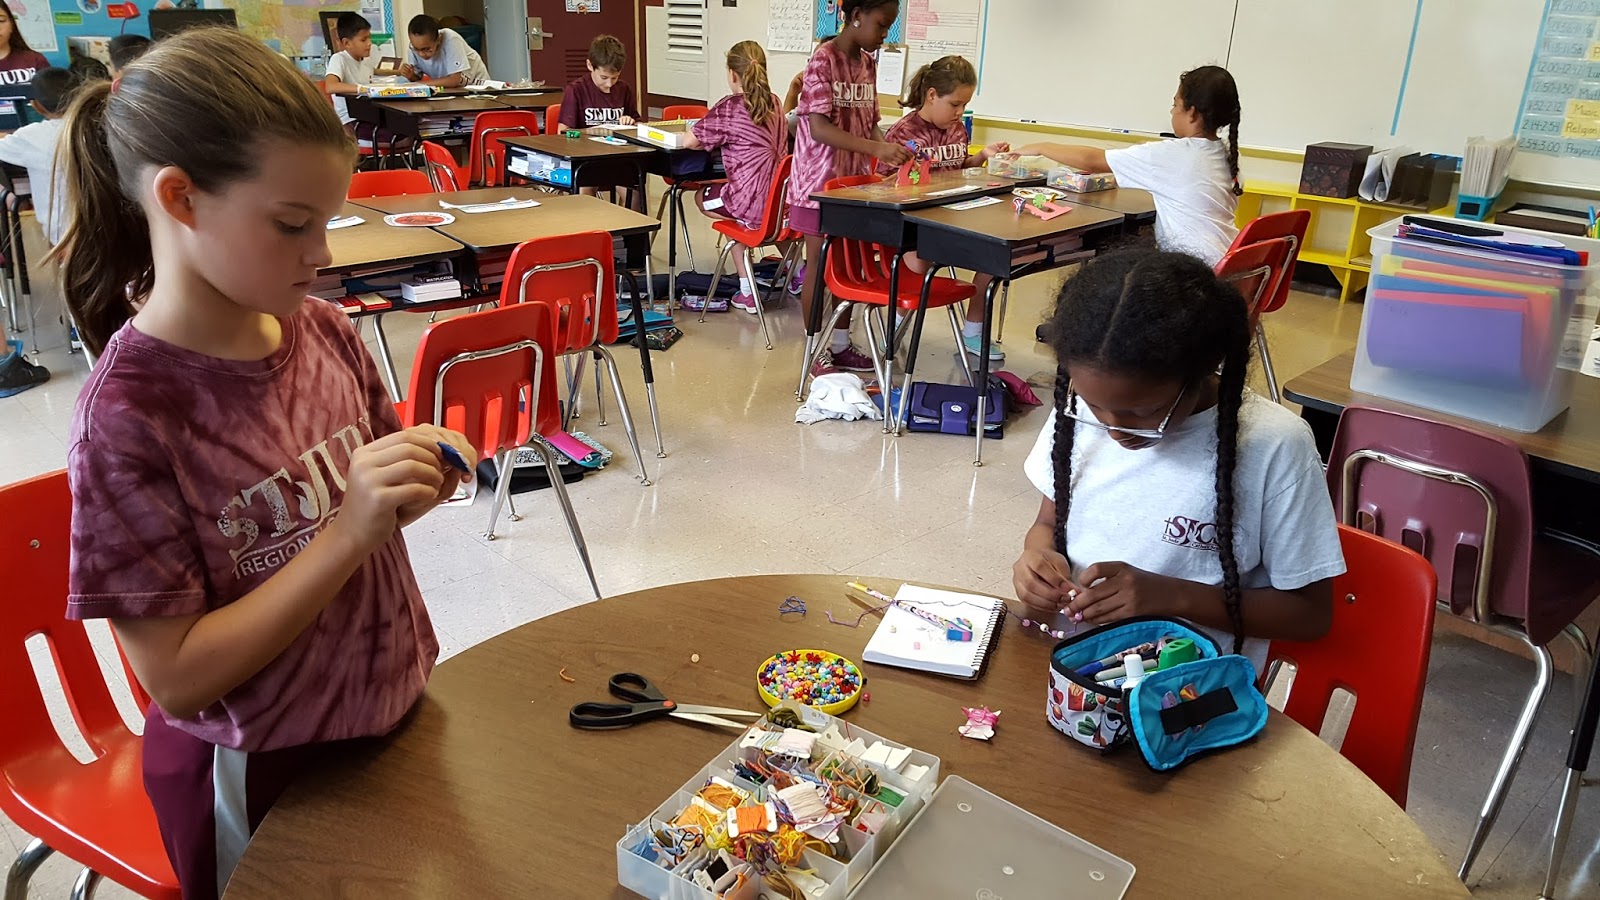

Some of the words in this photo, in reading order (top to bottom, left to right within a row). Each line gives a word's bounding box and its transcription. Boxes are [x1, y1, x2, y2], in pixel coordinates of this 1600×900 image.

[378, 88, 407, 96] TROUBLE
[1574, 104, 1598, 117] Music
[1565, 121, 1597, 136] Religion
[937, 142, 967, 163] JUDE
